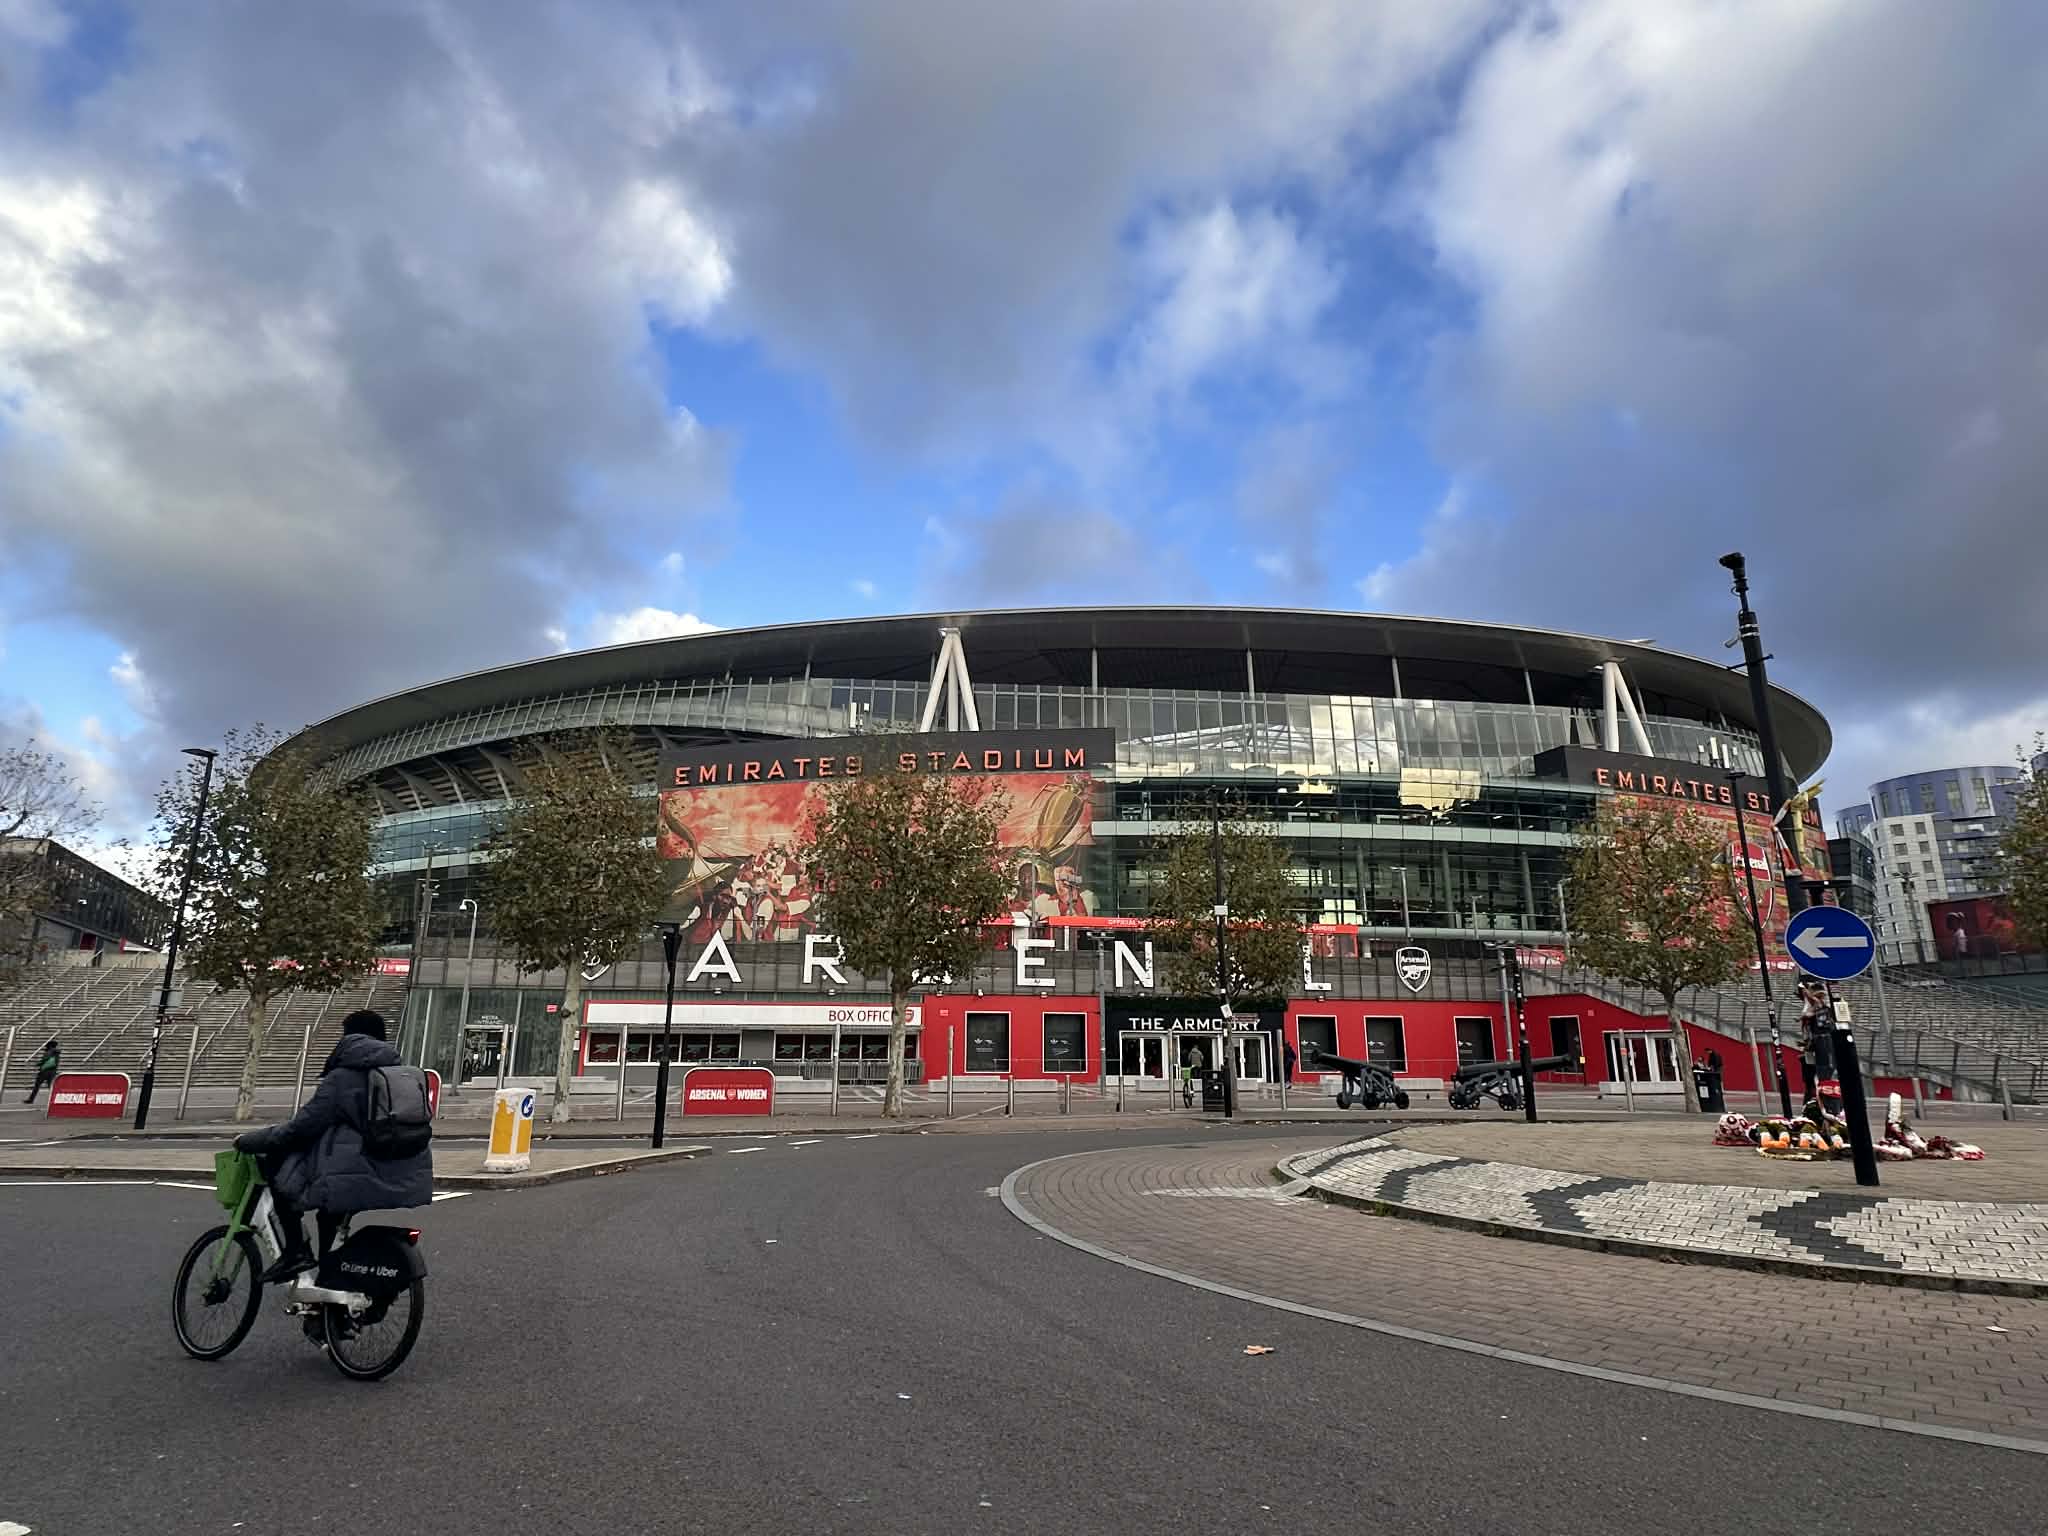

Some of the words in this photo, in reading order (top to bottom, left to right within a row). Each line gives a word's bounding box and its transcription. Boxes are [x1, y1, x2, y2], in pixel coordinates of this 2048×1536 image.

[674, 756, 863, 785] EMIRATES
[899, 748, 1085, 772] STADIUM
[1595, 767, 1732, 805] EMIRATES
[686, 929, 1333, 992] ARENL
[828, 1010, 854, 1022] BOX
[857, 1010, 893, 1022] OFFIC
[1128, 1018, 1164, 1030] THE
[689, 1088, 727, 1101] ARSENAL
[737, 1088, 768, 1100] WOMEN
[376, 1266, 398, 1277] Uber
